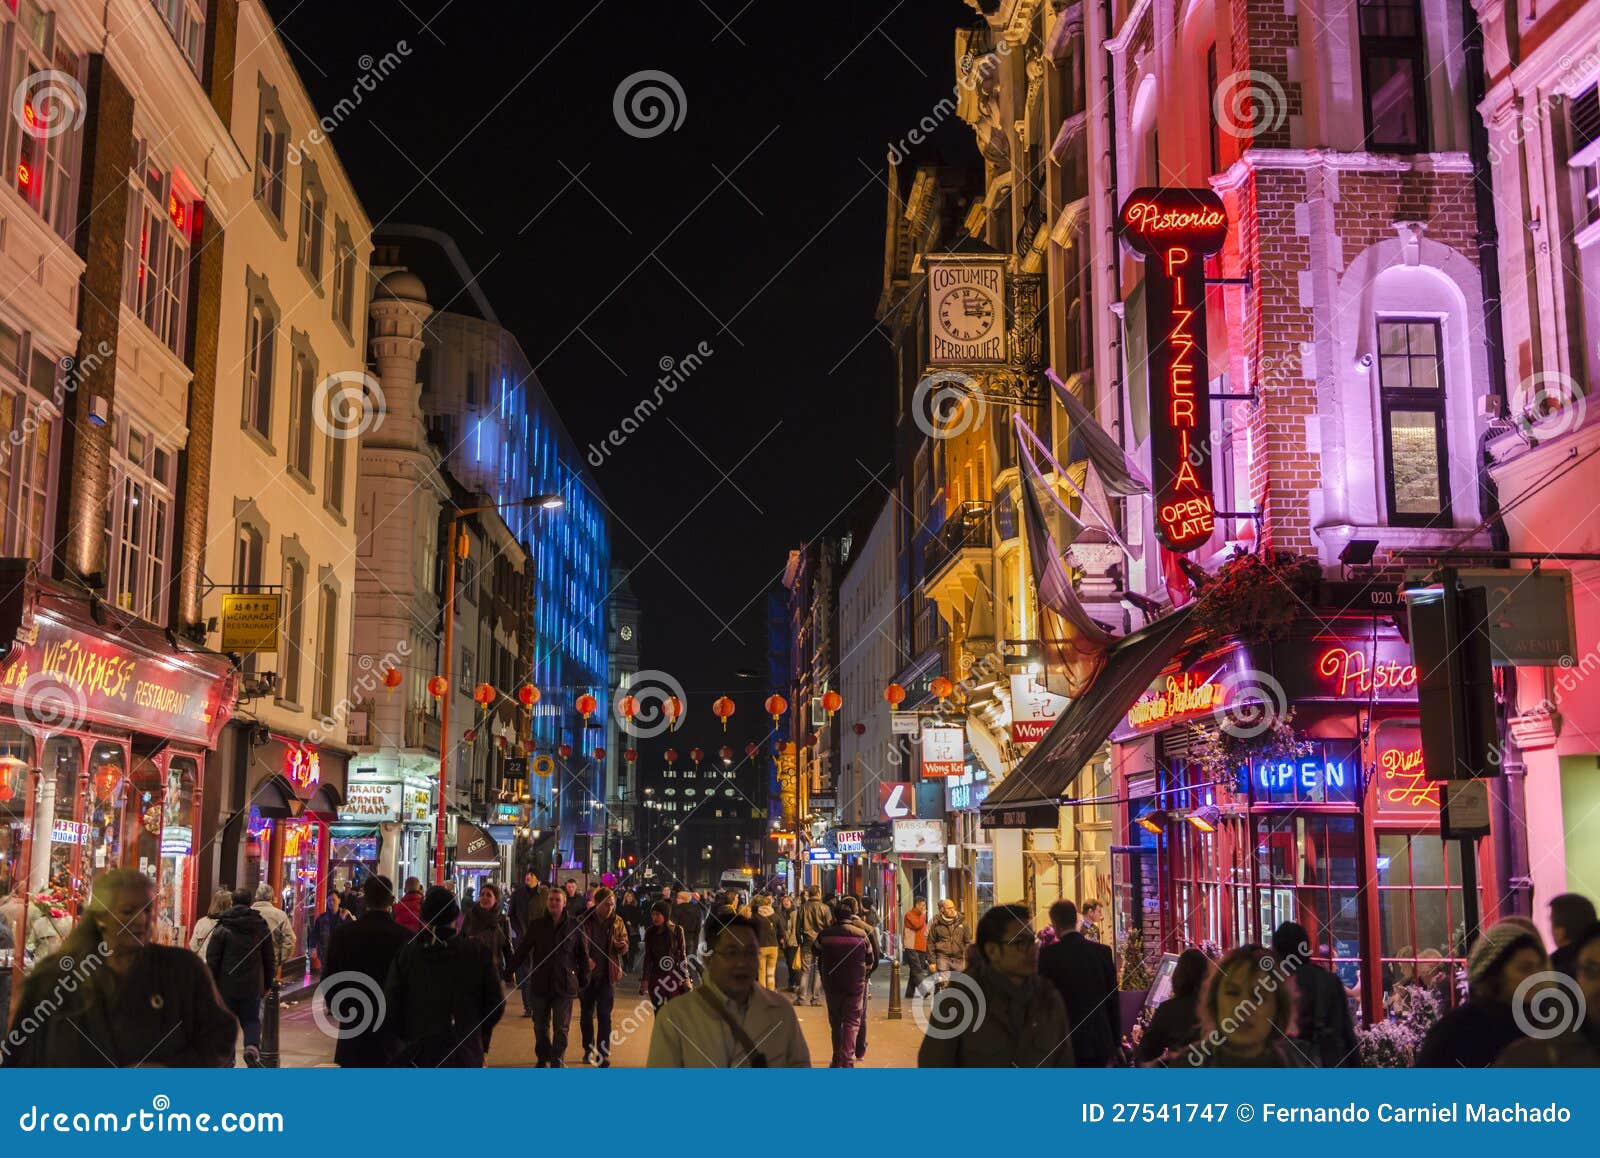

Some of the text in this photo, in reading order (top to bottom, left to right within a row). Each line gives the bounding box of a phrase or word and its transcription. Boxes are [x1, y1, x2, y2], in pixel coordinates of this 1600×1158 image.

[1128, 203, 1223, 233] Astoria
[934, 268, 999, 294] COSTUMIER
[934, 335, 1000, 360] PERRUQUIER
[1167, 247, 1199, 491] PIZZERIA
[1161, 496, 1211, 522] OPEN
[1171, 515, 1215, 539] LATE
[1371, 591, 1393, 604] 020
[41, 639, 137, 700] VIETNAMESE
[133, 680, 192, 716] RESTAURANT
[1321, 648, 1417, 695] Asto
[924, 763, 950, 774] Wong
[1260, 762, 1344, 788] OPEN
[350, 796, 385, 805] ORNER
[838, 831, 863, 843] OPEN
